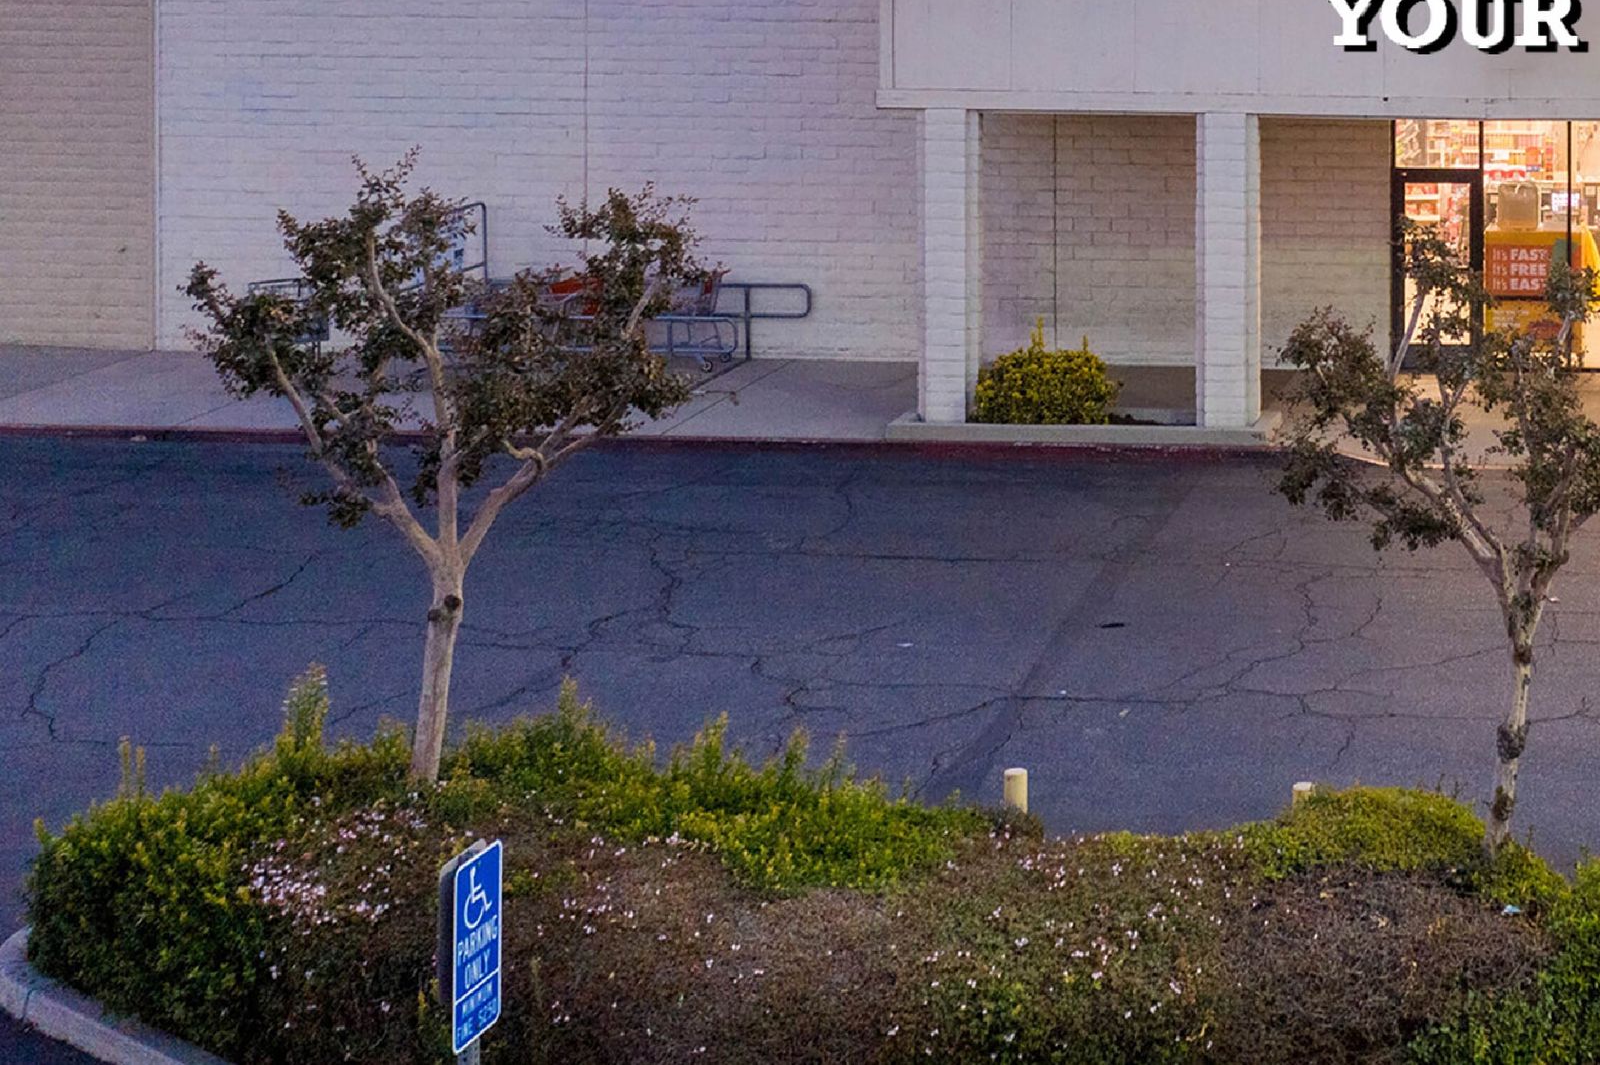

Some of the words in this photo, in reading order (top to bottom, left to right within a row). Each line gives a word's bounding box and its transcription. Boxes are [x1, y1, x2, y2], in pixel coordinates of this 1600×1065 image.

[1492, 248, 1508, 261] It's
[1510, 248, 1548, 261] FAST
[1492, 262, 1508, 276] It's
[1510, 262, 1547, 276] FREE
[1492, 277, 1508, 291] It's
[457, 914, 498, 967] PARKING
[464, 948, 491, 990] ONLY
[462, 980, 493, 1020] MINIMUM
[456, 1017, 474, 1045] FINE
